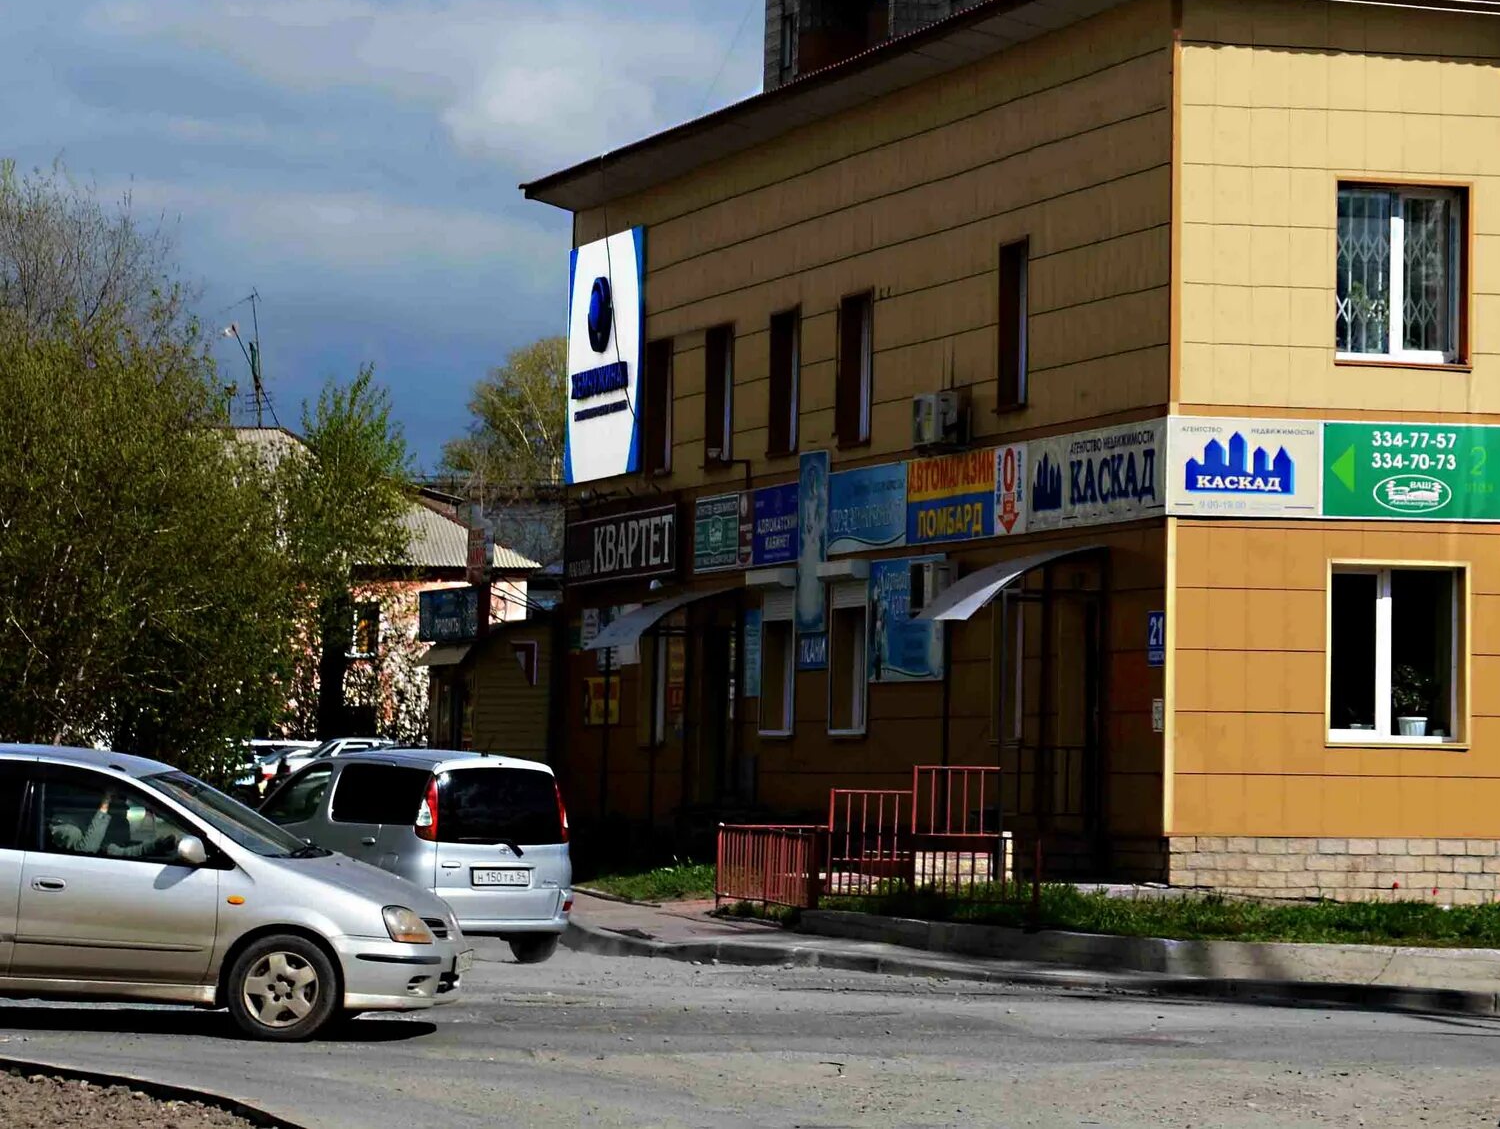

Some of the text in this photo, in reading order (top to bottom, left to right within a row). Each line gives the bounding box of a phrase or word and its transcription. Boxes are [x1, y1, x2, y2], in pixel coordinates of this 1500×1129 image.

[1251, 428, 1315, 436] НЕДВИЖИМОСТИ
[1371, 431, 1457, 448] 334-77-57
[1069, 430, 1155, 456] АГЕНТСТВО НЕДВИЖИМОСТИ
[909, 448, 995, 495] АВТОМАГАЗИН
[1371, 453, 1457, 470] 334-70-73
[1069, 448, 1156, 506] КАСКАД
[1196, 475, 1282, 492] КАСКАД
[593, 513, 674, 574] КВАРТЕТ
